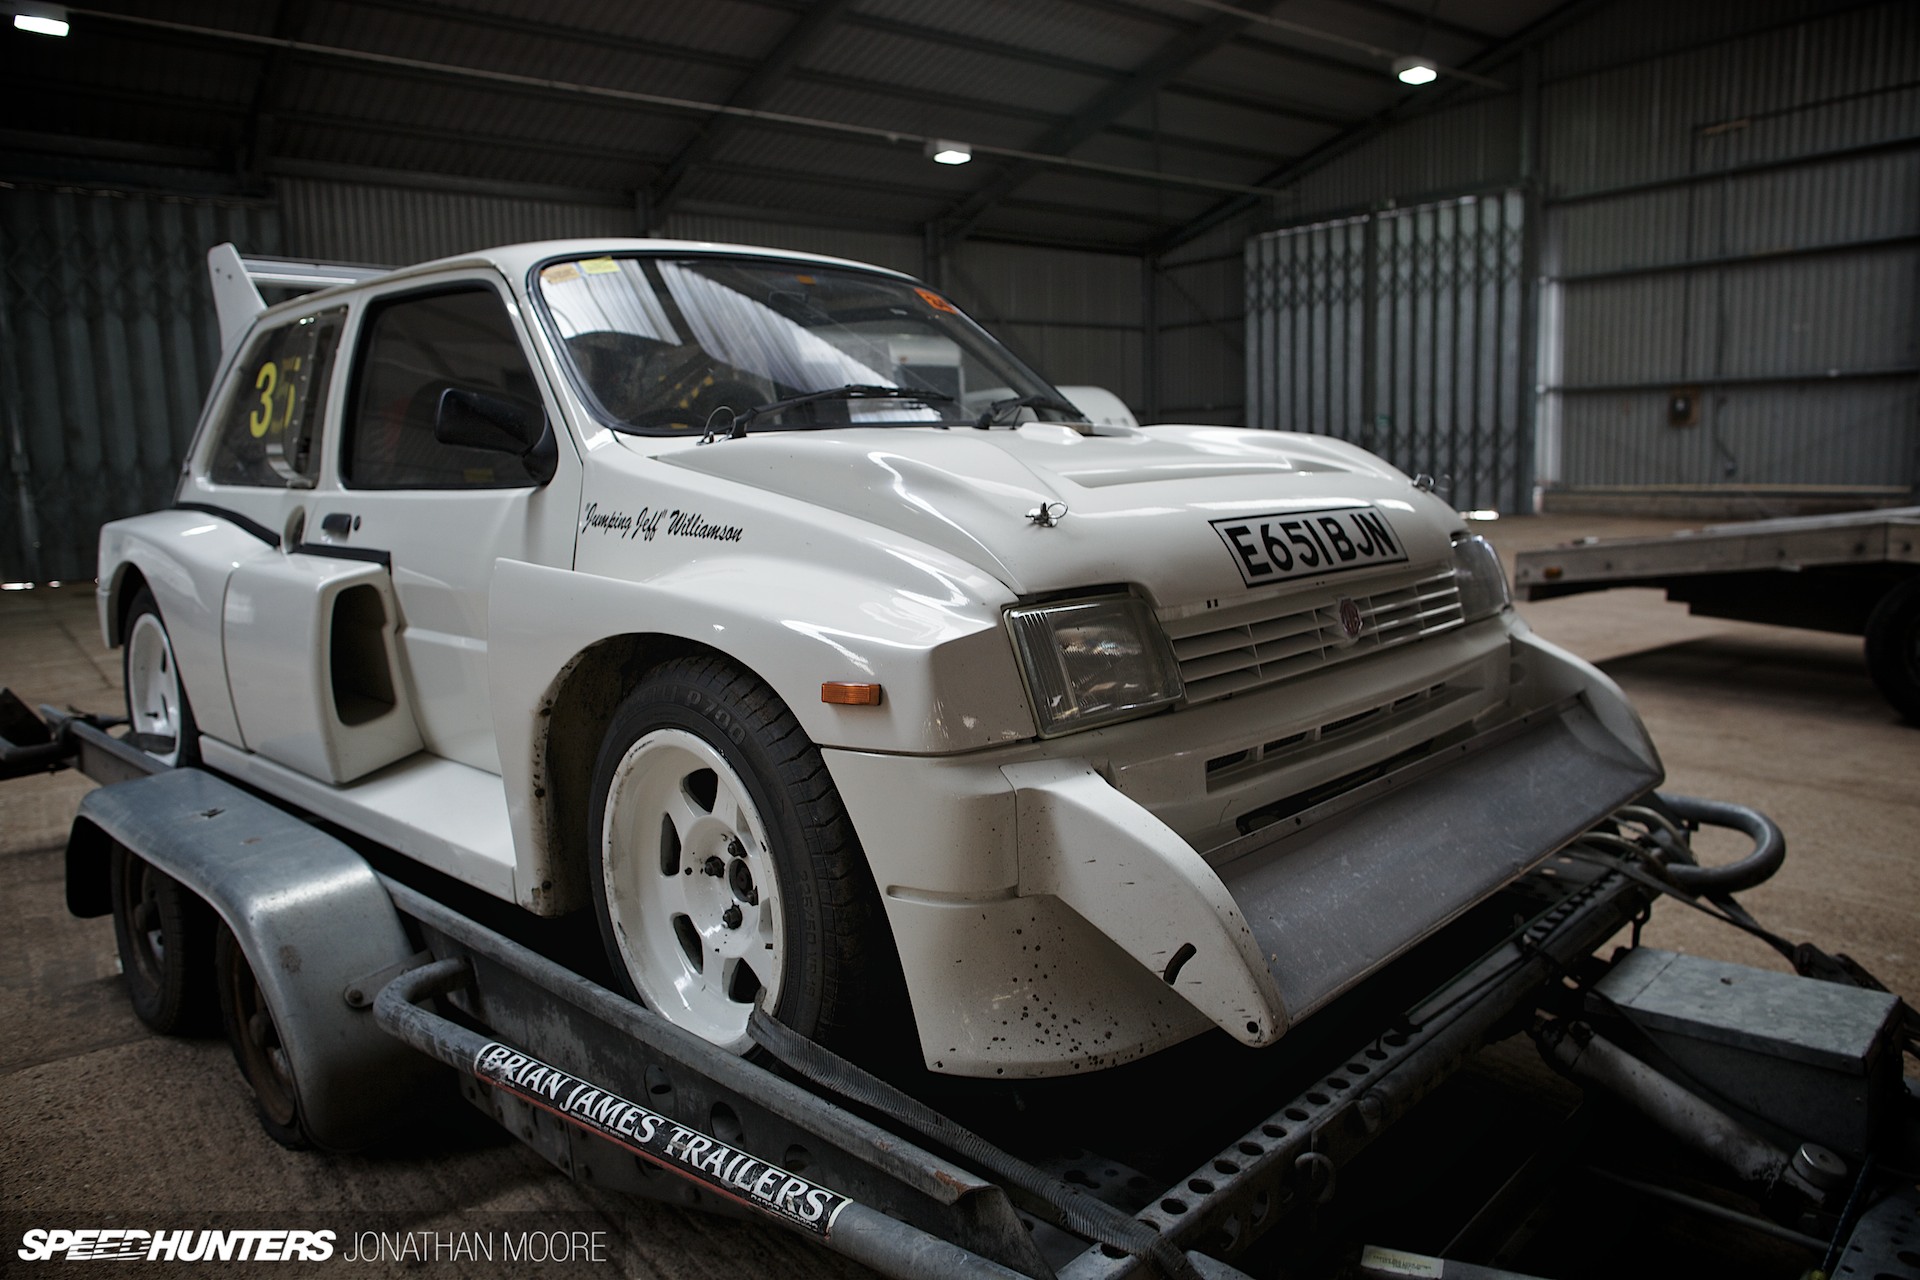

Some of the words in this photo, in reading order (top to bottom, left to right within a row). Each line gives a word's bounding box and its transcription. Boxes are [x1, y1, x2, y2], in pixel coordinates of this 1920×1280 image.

[667, 509, 743, 543] Williamson
[1224, 512, 1398, 577] E651BJN
[484, 1048, 570, 1100] BRIAN
[558, 1083, 666, 1143] JAMES
[664, 1126, 834, 1222] TRAILERS
